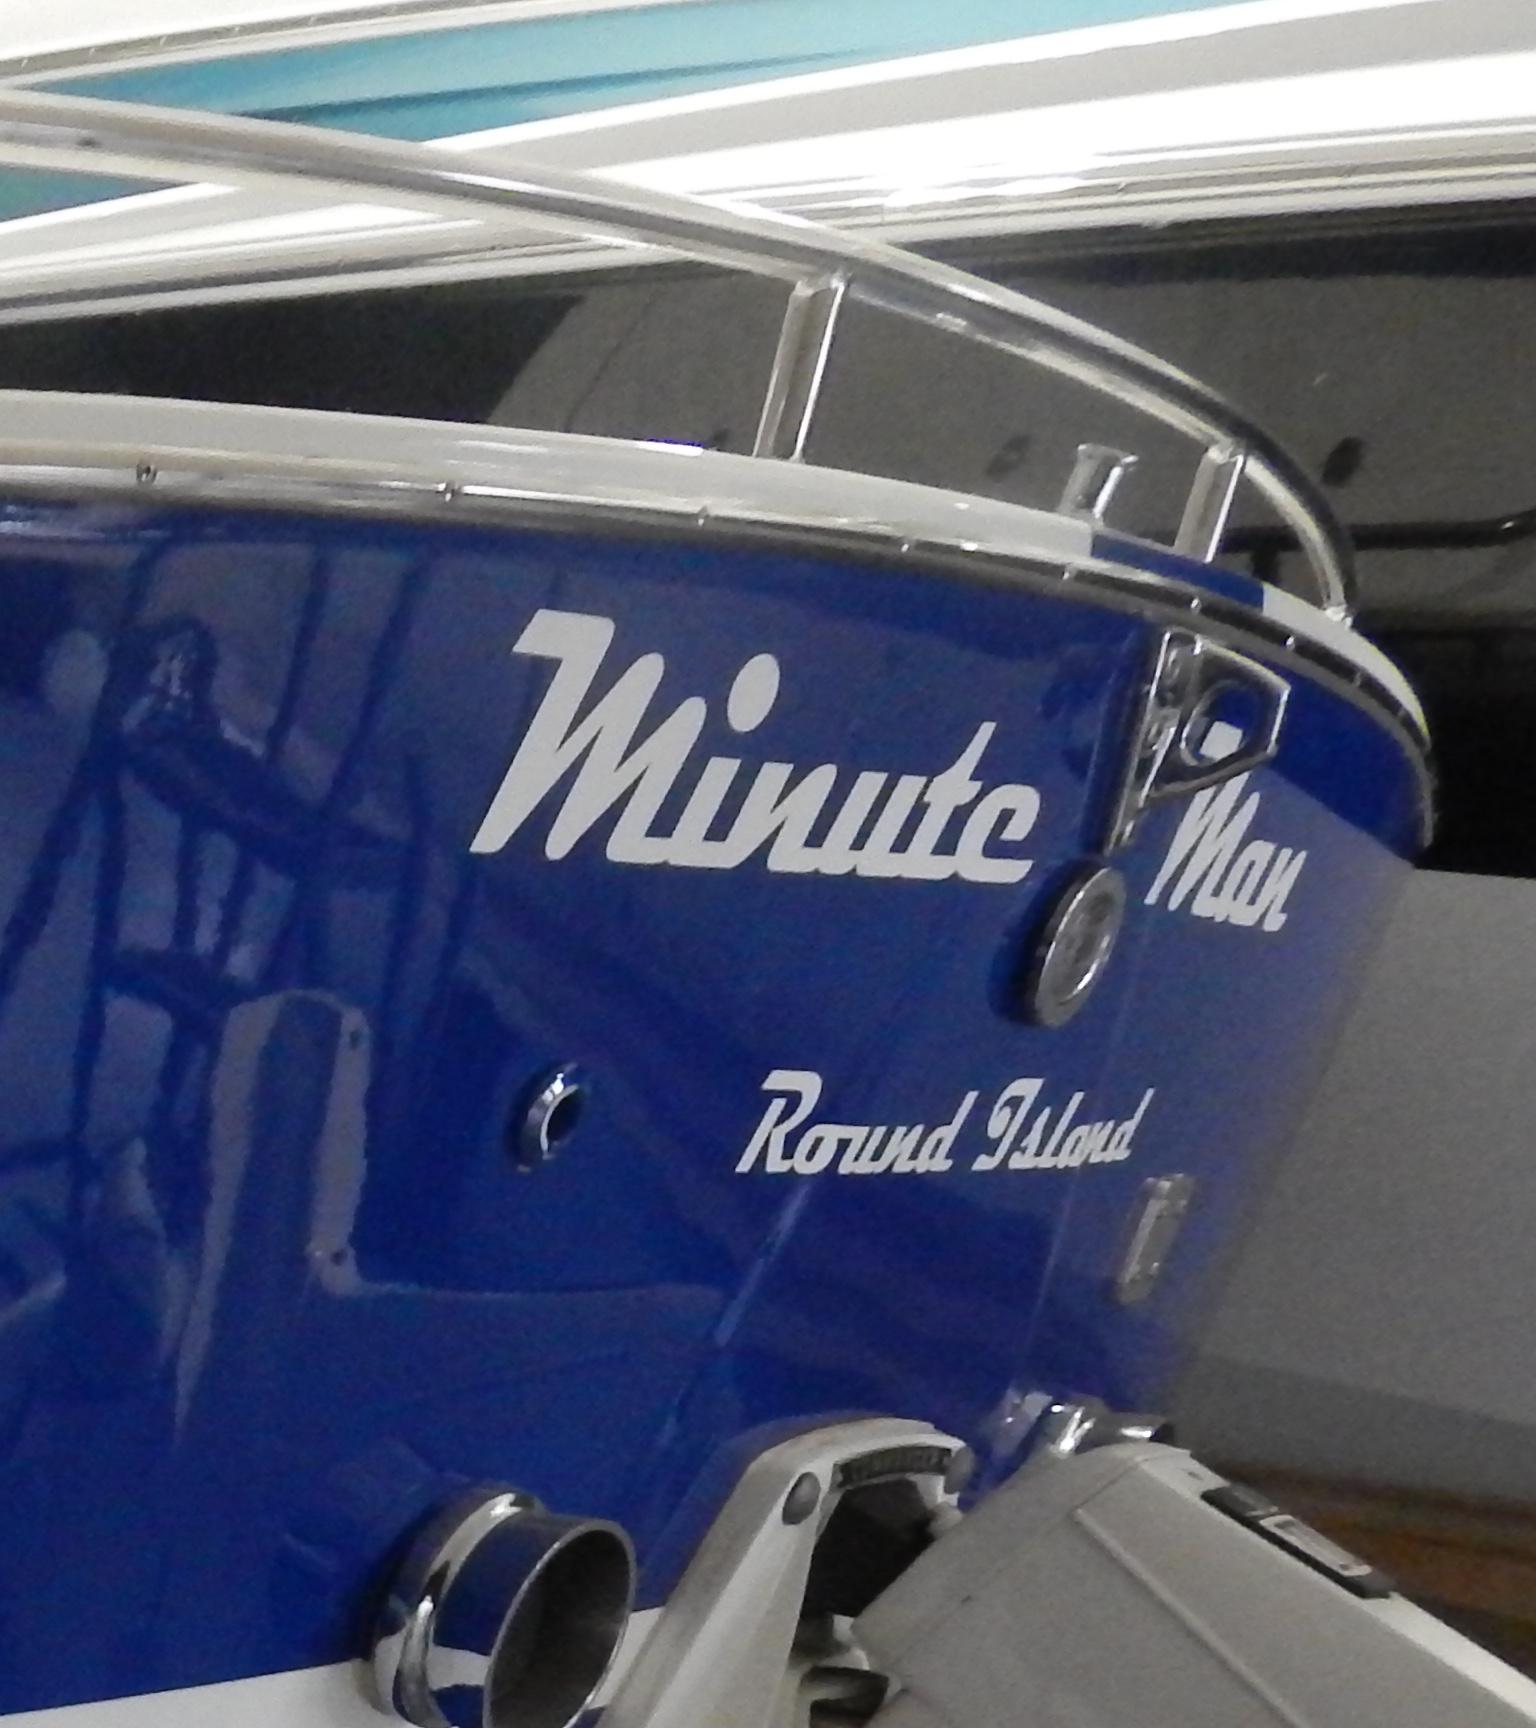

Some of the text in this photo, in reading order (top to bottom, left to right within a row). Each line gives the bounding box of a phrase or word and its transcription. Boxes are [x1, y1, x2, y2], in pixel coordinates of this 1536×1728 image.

[469, 608, 1309, 932] Minute Man
[736, 1069, 1155, 1174] Round Island
